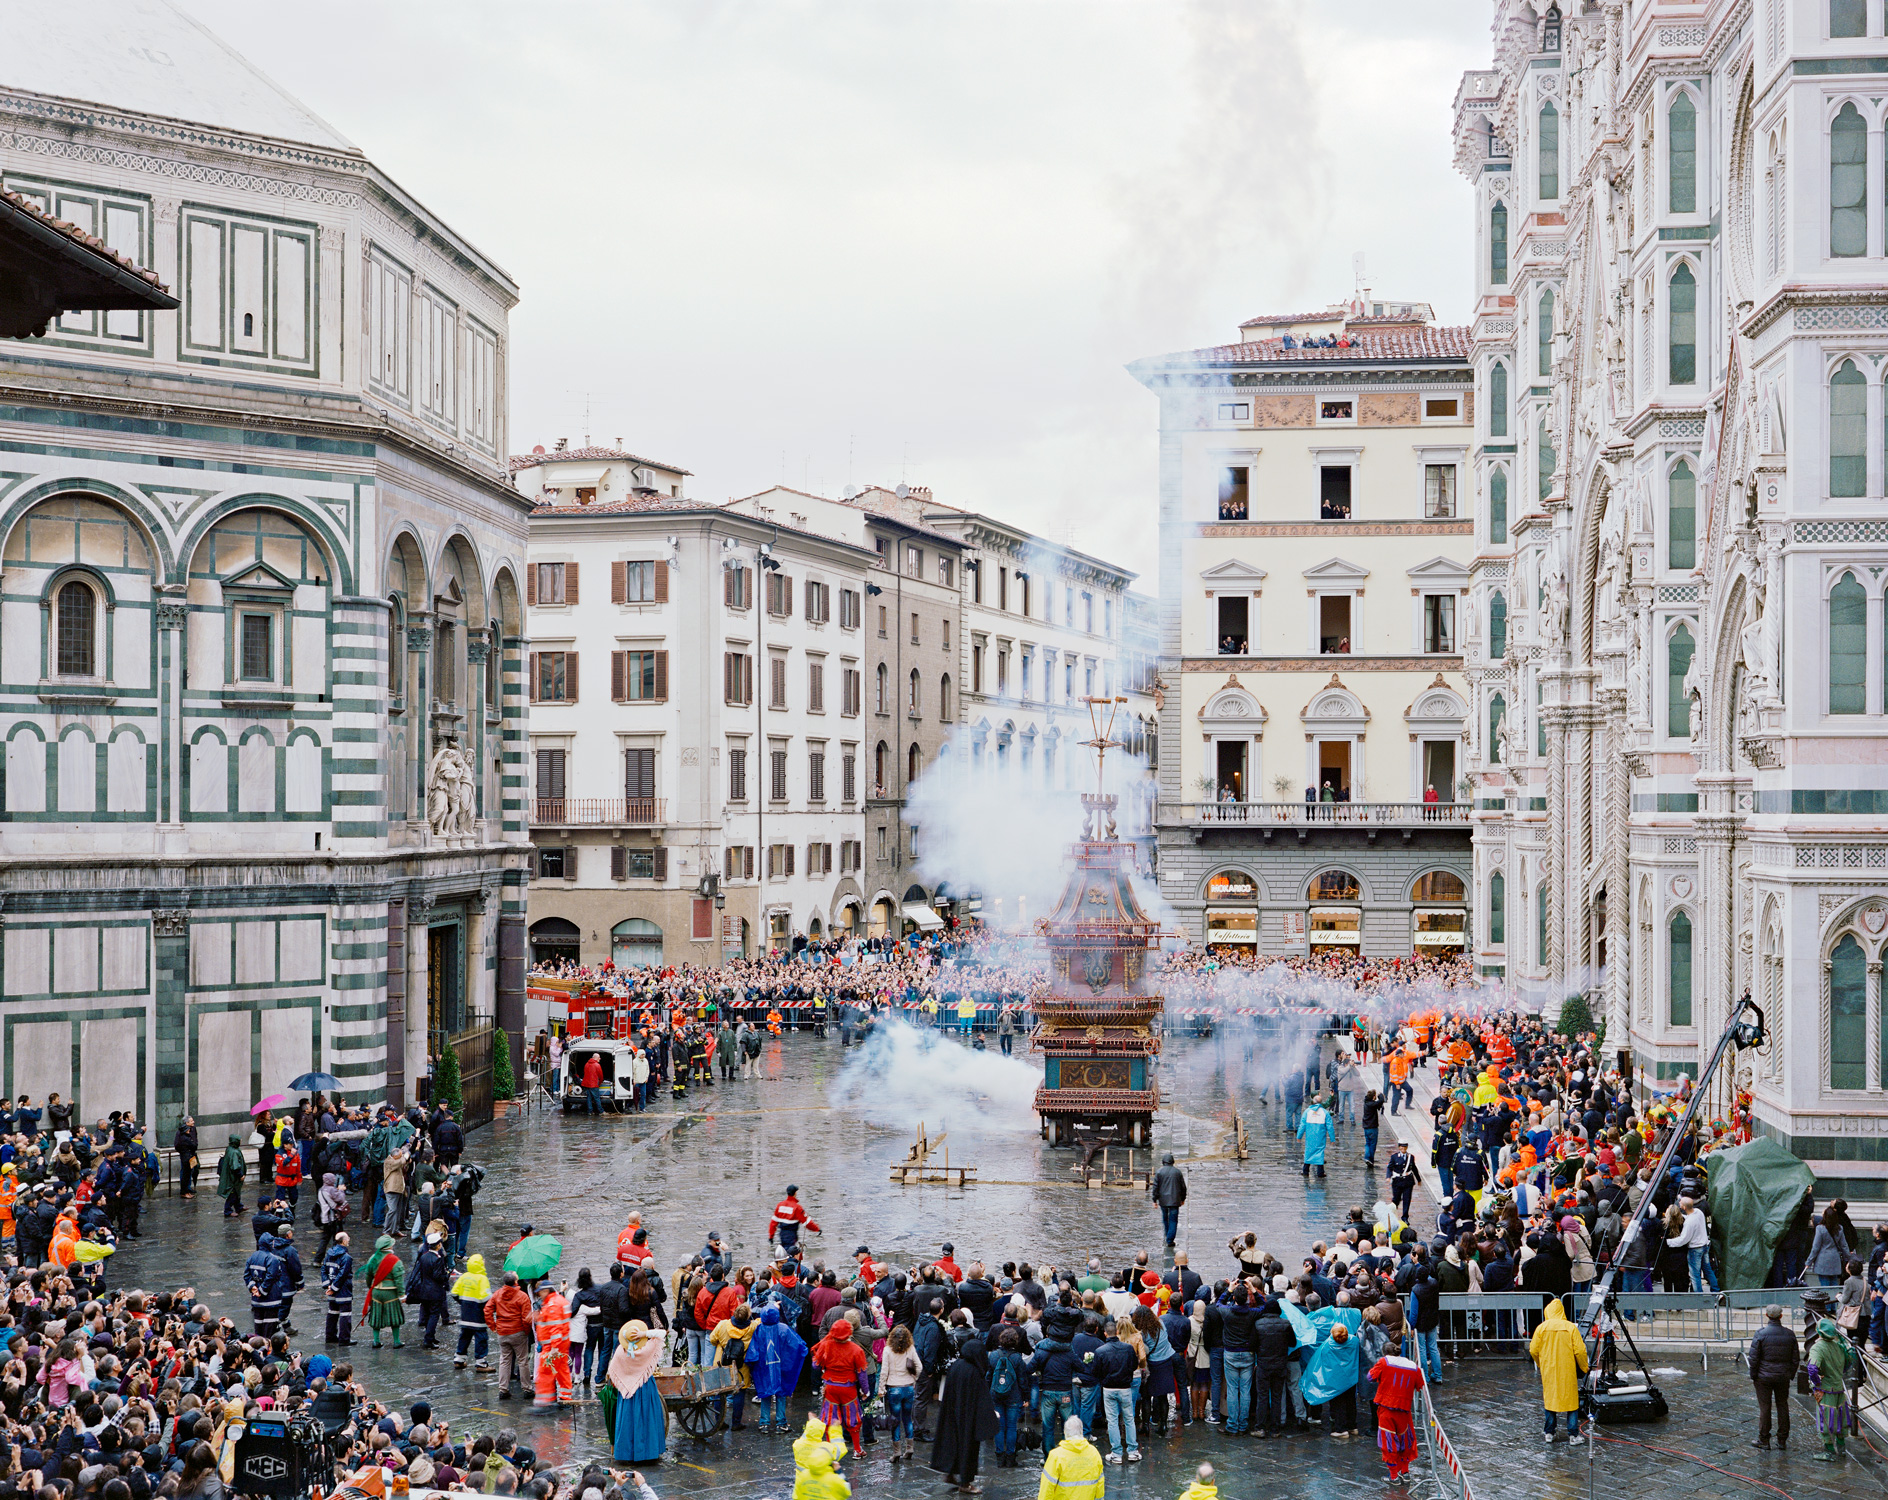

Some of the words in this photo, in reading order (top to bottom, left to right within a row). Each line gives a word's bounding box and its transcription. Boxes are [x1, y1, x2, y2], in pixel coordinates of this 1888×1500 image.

[1211, 884, 1251, 892] MOKARICO
[1213, 931, 1251, 941] Caffetteria
[1315, 932, 1332, 942] Self
[1332, 933, 1355, 941] Service
[1420, 934, 1442, 942] Snack
[1443, 934, 1459, 942] Bar
[247, 1456, 285, 1478] MEC
